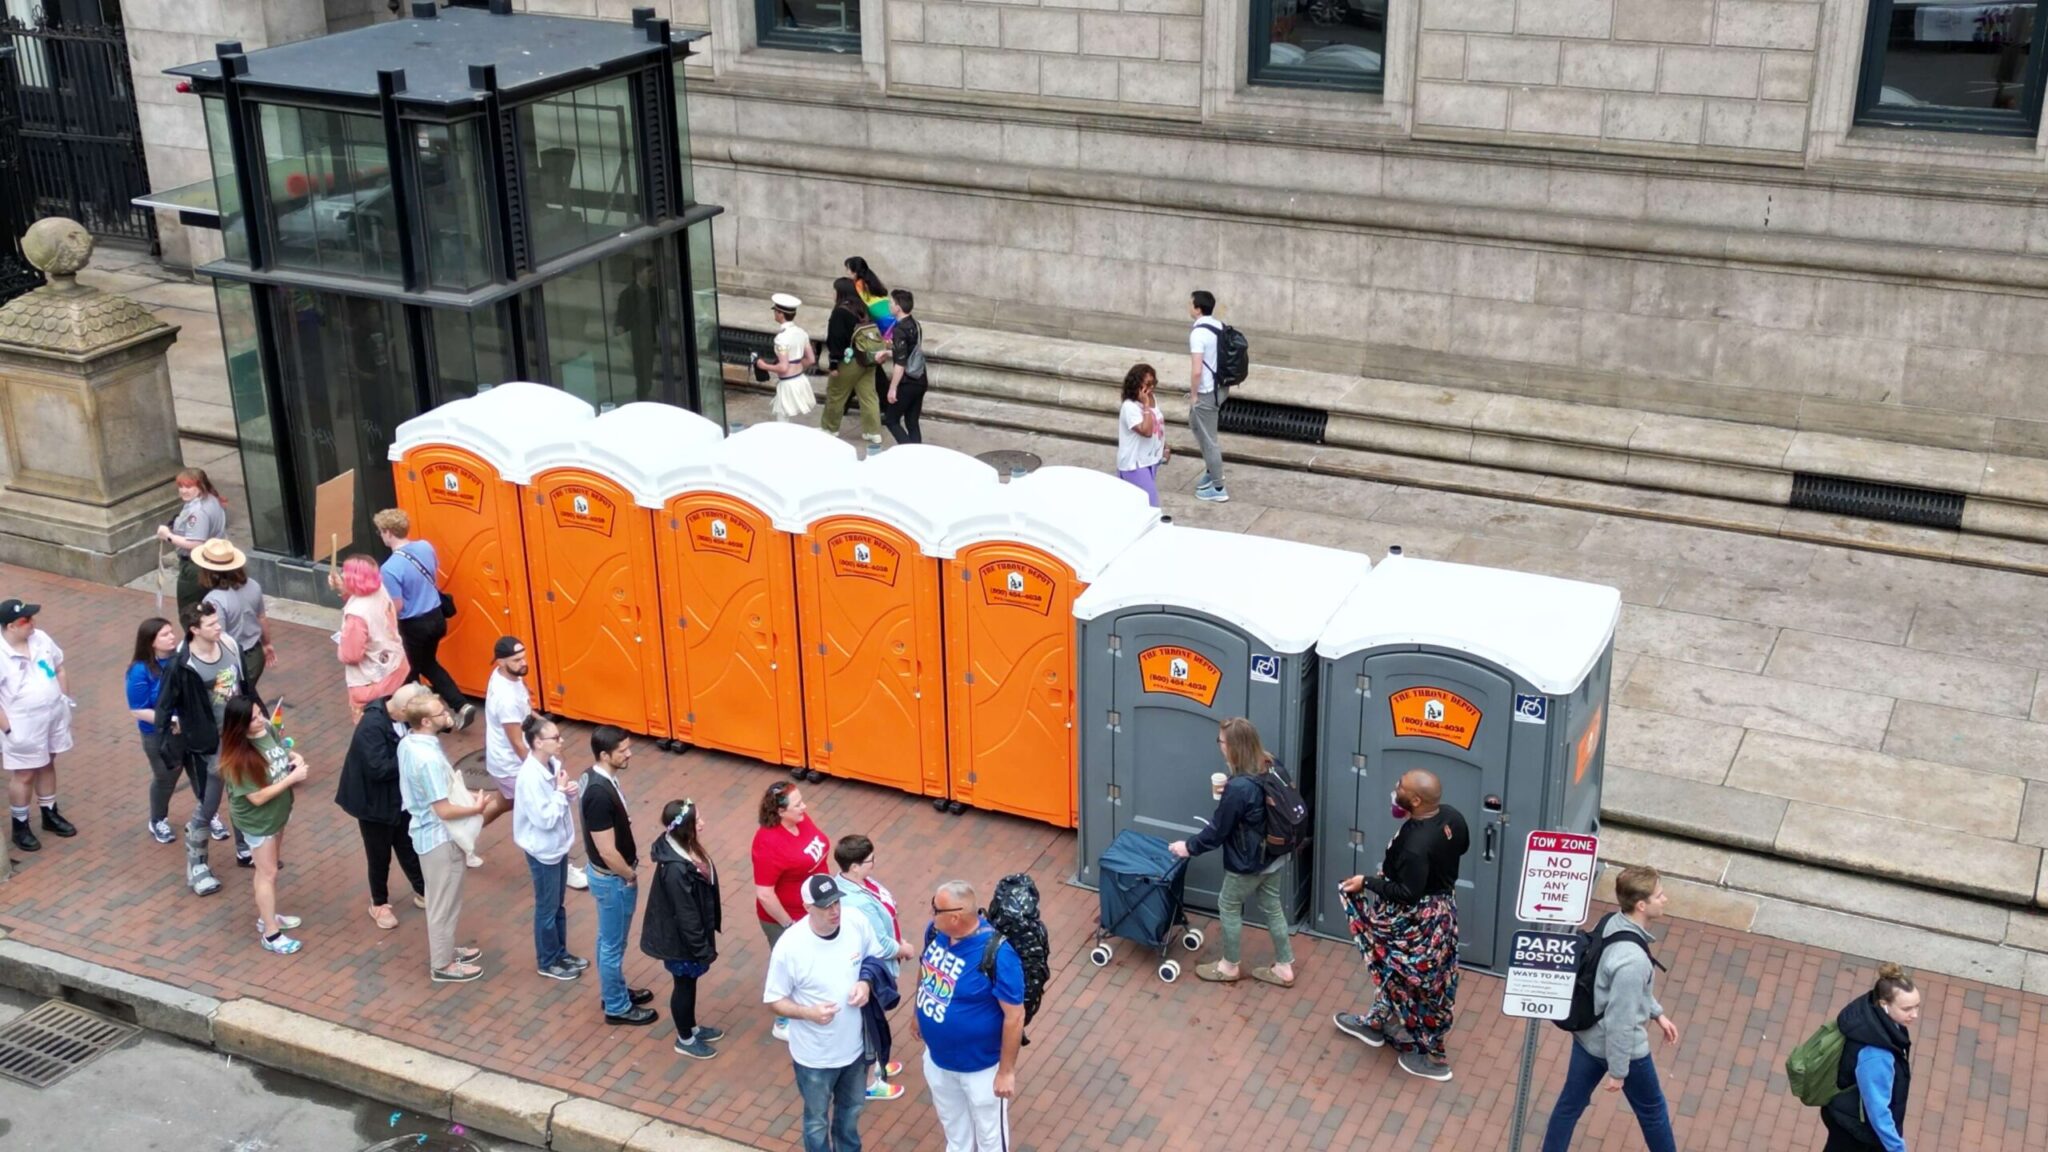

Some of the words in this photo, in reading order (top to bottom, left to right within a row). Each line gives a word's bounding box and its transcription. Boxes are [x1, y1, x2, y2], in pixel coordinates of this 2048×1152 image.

[1142, 651, 1157, 661] THE
[1159, 648, 1191, 658] THRONE
[1194, 655, 1217, 675] DEPOT
[1393, 692, 1410, 703] THE
[1413, 689, 1449, 700] THRONE
[1450, 696, 1477, 716] DEPOT
[1402, 716, 1423, 727] (800)
[1532, 836, 1556, 848] TOW
[1561, 838, 1594, 851] ZONE
[1547, 856, 1572, 868] NO
[1528, 868, 1588, 881] STOPPING
[1543, 881, 1568, 890] ANY
[1541, 892, 1569, 902] TIME
[1516, 936, 1576, 954] PARK
[924, 940, 966, 981] FREE
[1514, 951, 1575, 964] BOSTON
[1513, 970, 1538, 978] WAYS
[1520, 1001, 1553, 1014] 1001
